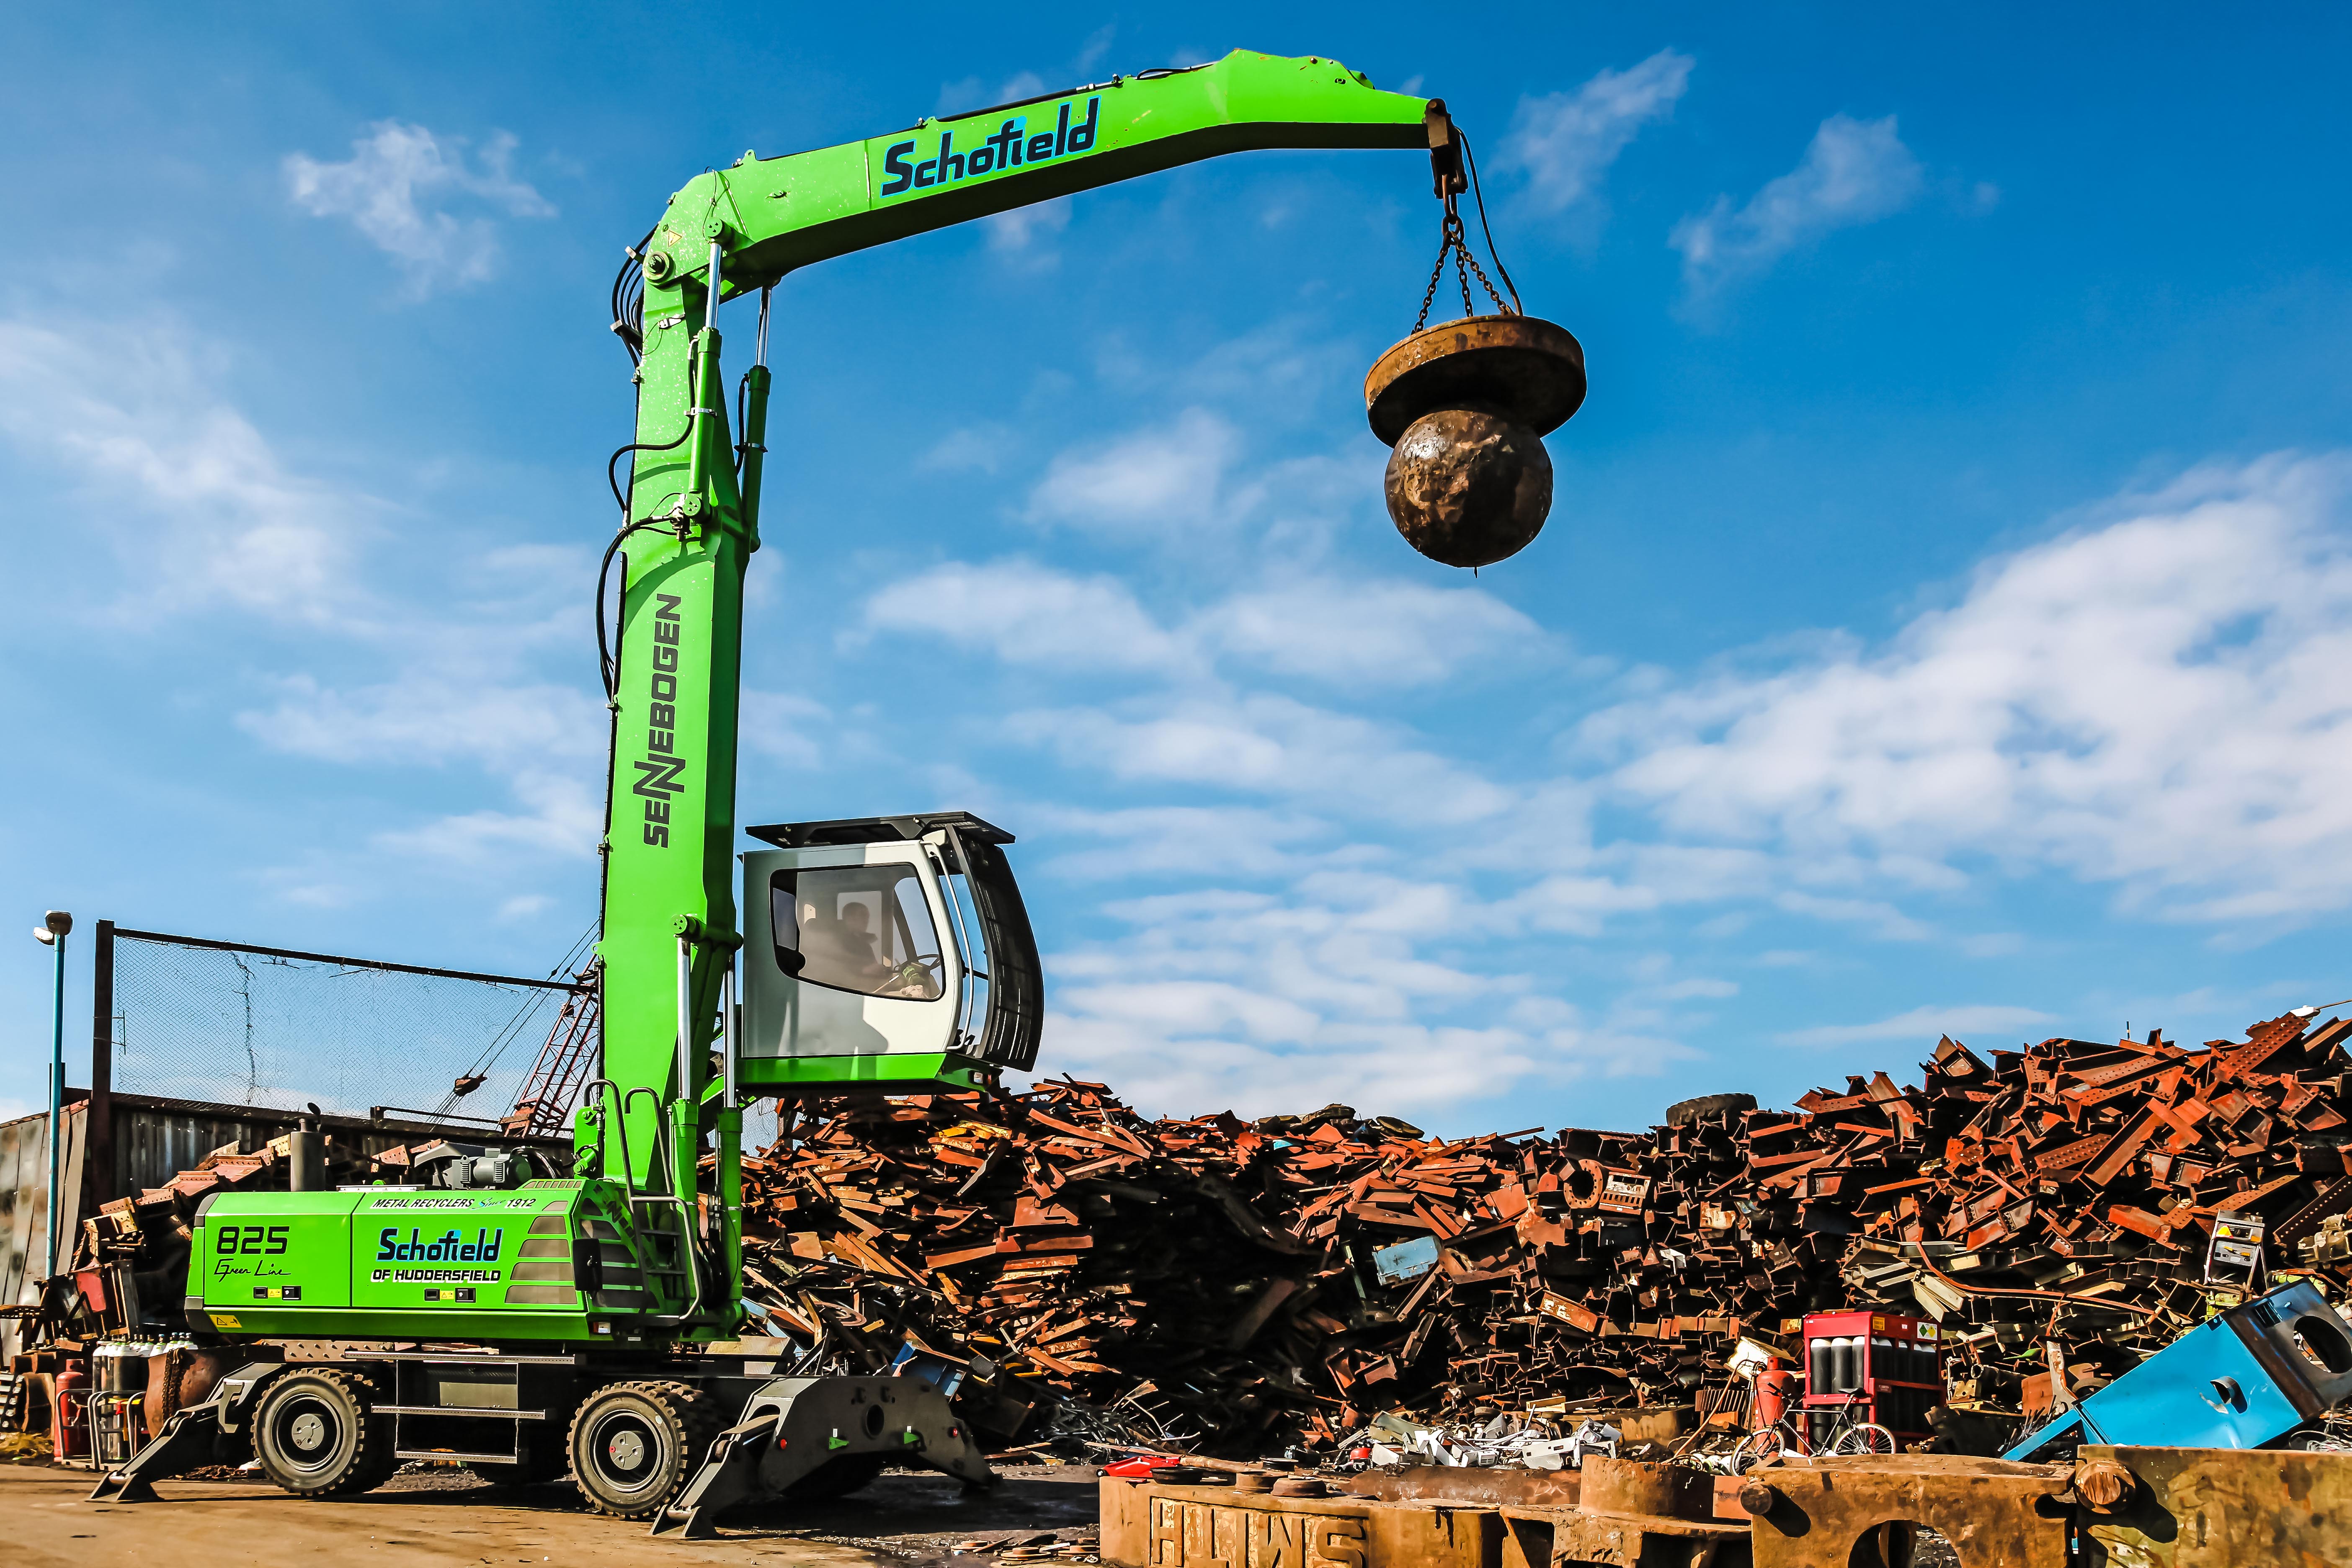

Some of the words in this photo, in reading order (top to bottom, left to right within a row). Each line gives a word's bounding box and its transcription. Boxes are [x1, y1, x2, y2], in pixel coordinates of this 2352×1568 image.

[880, 95, 1101, 197] Schofield
[633, 593, 686, 848] SENNEBOGEN
[371, 1199, 410, 1209] METAL
[409, 1199, 475, 1208] RECYCLERS
[471, 1197, 506, 1210] Since
[505, 1198, 536, 1208] 1912
[217, 1226, 290, 1254] 825
[376, 1228, 503, 1262] Schofield
[214, 1259, 251, 1282] Green
[254, 1259, 291, 1276] Line
[371, 1269, 391, 1282] OF
[393, 1269, 501, 1283] HUDDERSFIELD
